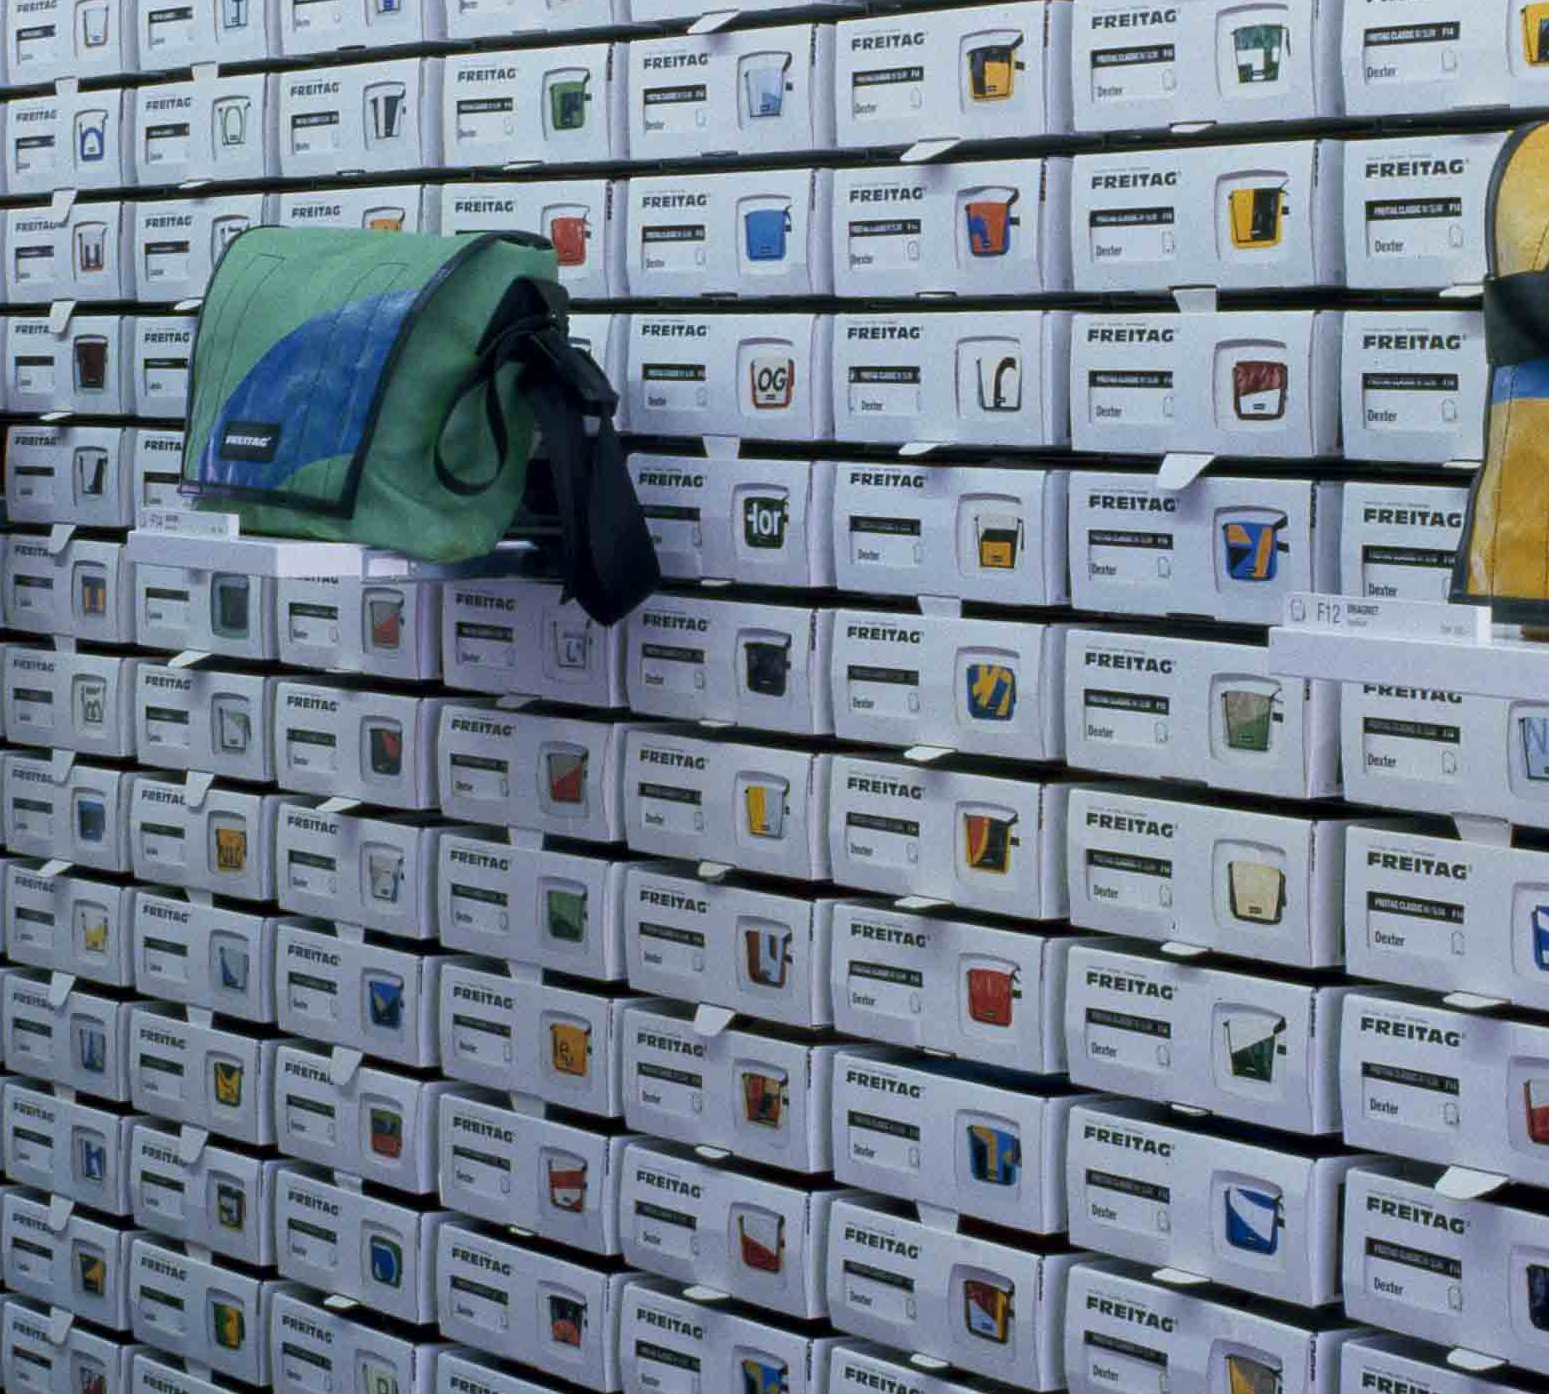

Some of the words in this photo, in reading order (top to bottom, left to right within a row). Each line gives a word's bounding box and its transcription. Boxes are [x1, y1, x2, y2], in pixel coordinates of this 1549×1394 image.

[852, 33, 924, 50] FREITAG
[1092, 172, 1176, 189] FREITAG
[1366, 160, 1463, 177] FREITAG
[1317, 601, 1341, 623] F12
[1368, 852, 1466, 879] FREITAG
[847, 1071, 920, 1098] FREITAG
[1084, 1126, 1170, 1157] FREITAG
[1367, 1197, 1465, 1234] FREITAG
